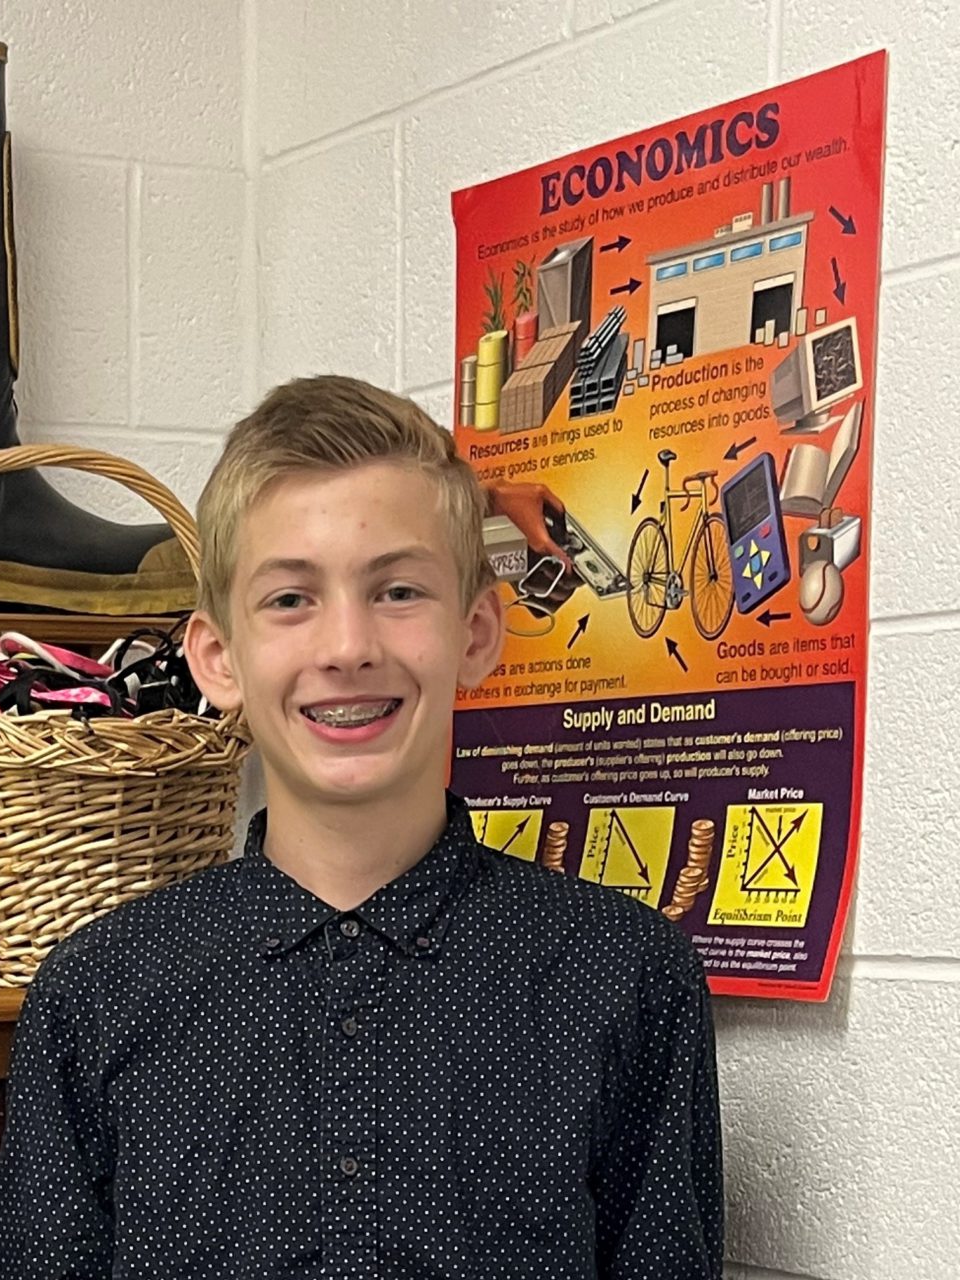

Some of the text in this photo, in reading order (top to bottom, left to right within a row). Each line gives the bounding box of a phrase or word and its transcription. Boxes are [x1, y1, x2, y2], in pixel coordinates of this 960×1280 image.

[540, 102, 780, 216] ECONOMICS
[478, 153, 801, 259] Economics the study of how we produce and distribute our
[652, 356, 764, 392] Production is the
[649, 381, 766, 420] process of changing
[649, 403, 770, 440] resources into goods.
[469, 418, 623, 461] Resources are things used to
[476, 447, 597, 482] oduce goods or services.
[489, 550, 526, 577] XPRESS
[717, 633, 855, 660] Goods are items that
[509, 663, 525, 676] are
[528, 659, 563, 674] actions
[566, 656, 591, 671] done
[716, 658, 852, 683] can be bought or sold.
[470, 675, 627, 700] others in exchange for payment.
[563, 698, 716, 732] Supply and Demand
[529, 794, 552, 806] Curve
[583, 790, 689, 805] Customer's Curve
[748, 787, 804, 800] Market Price
[727, 825, 739, 858] Price
[713, 908, 802, 924] Equilibrium Point
